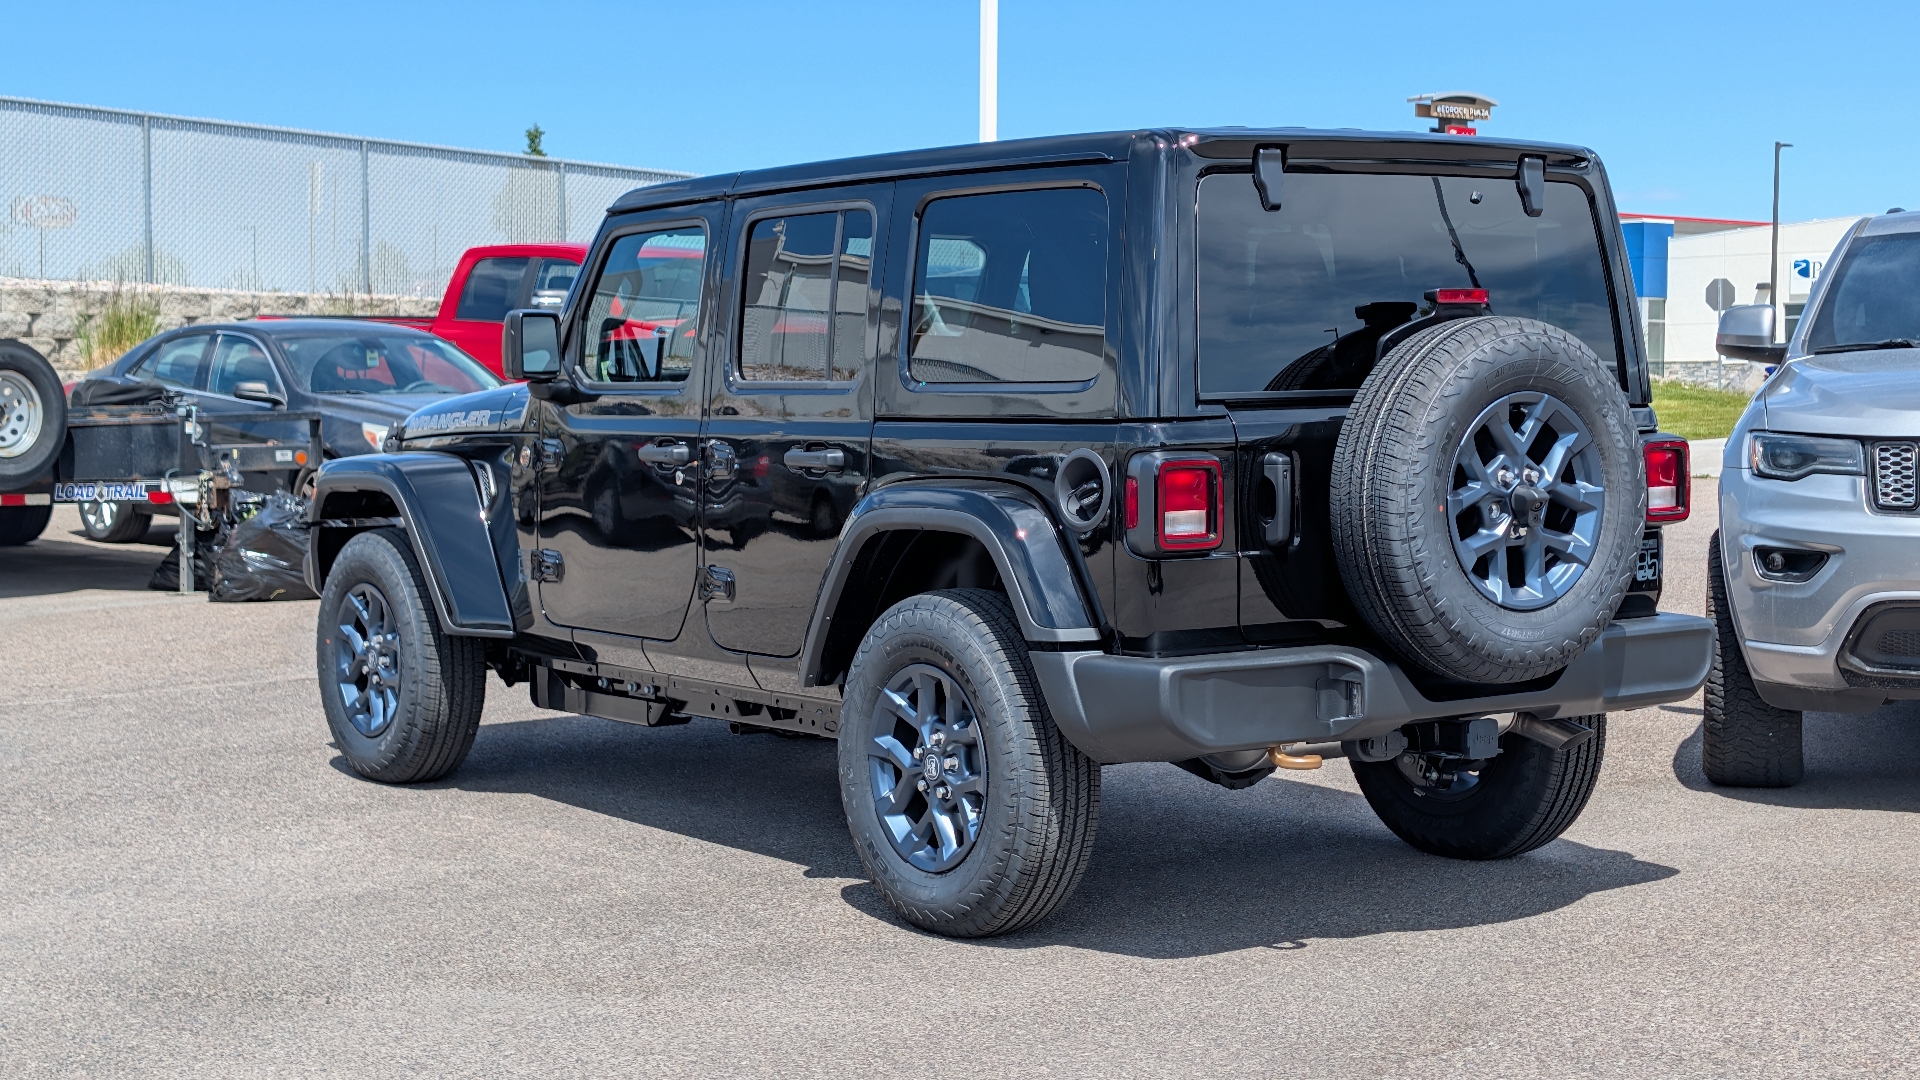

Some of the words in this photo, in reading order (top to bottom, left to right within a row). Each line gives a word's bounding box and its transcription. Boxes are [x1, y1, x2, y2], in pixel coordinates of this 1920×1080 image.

[1469, 107, 1489, 117] PLAZA
[408, 410, 491, 431] WRANGLER
[54, 482, 97, 501] LOAD
[104, 482, 149, 501] TRAIL
